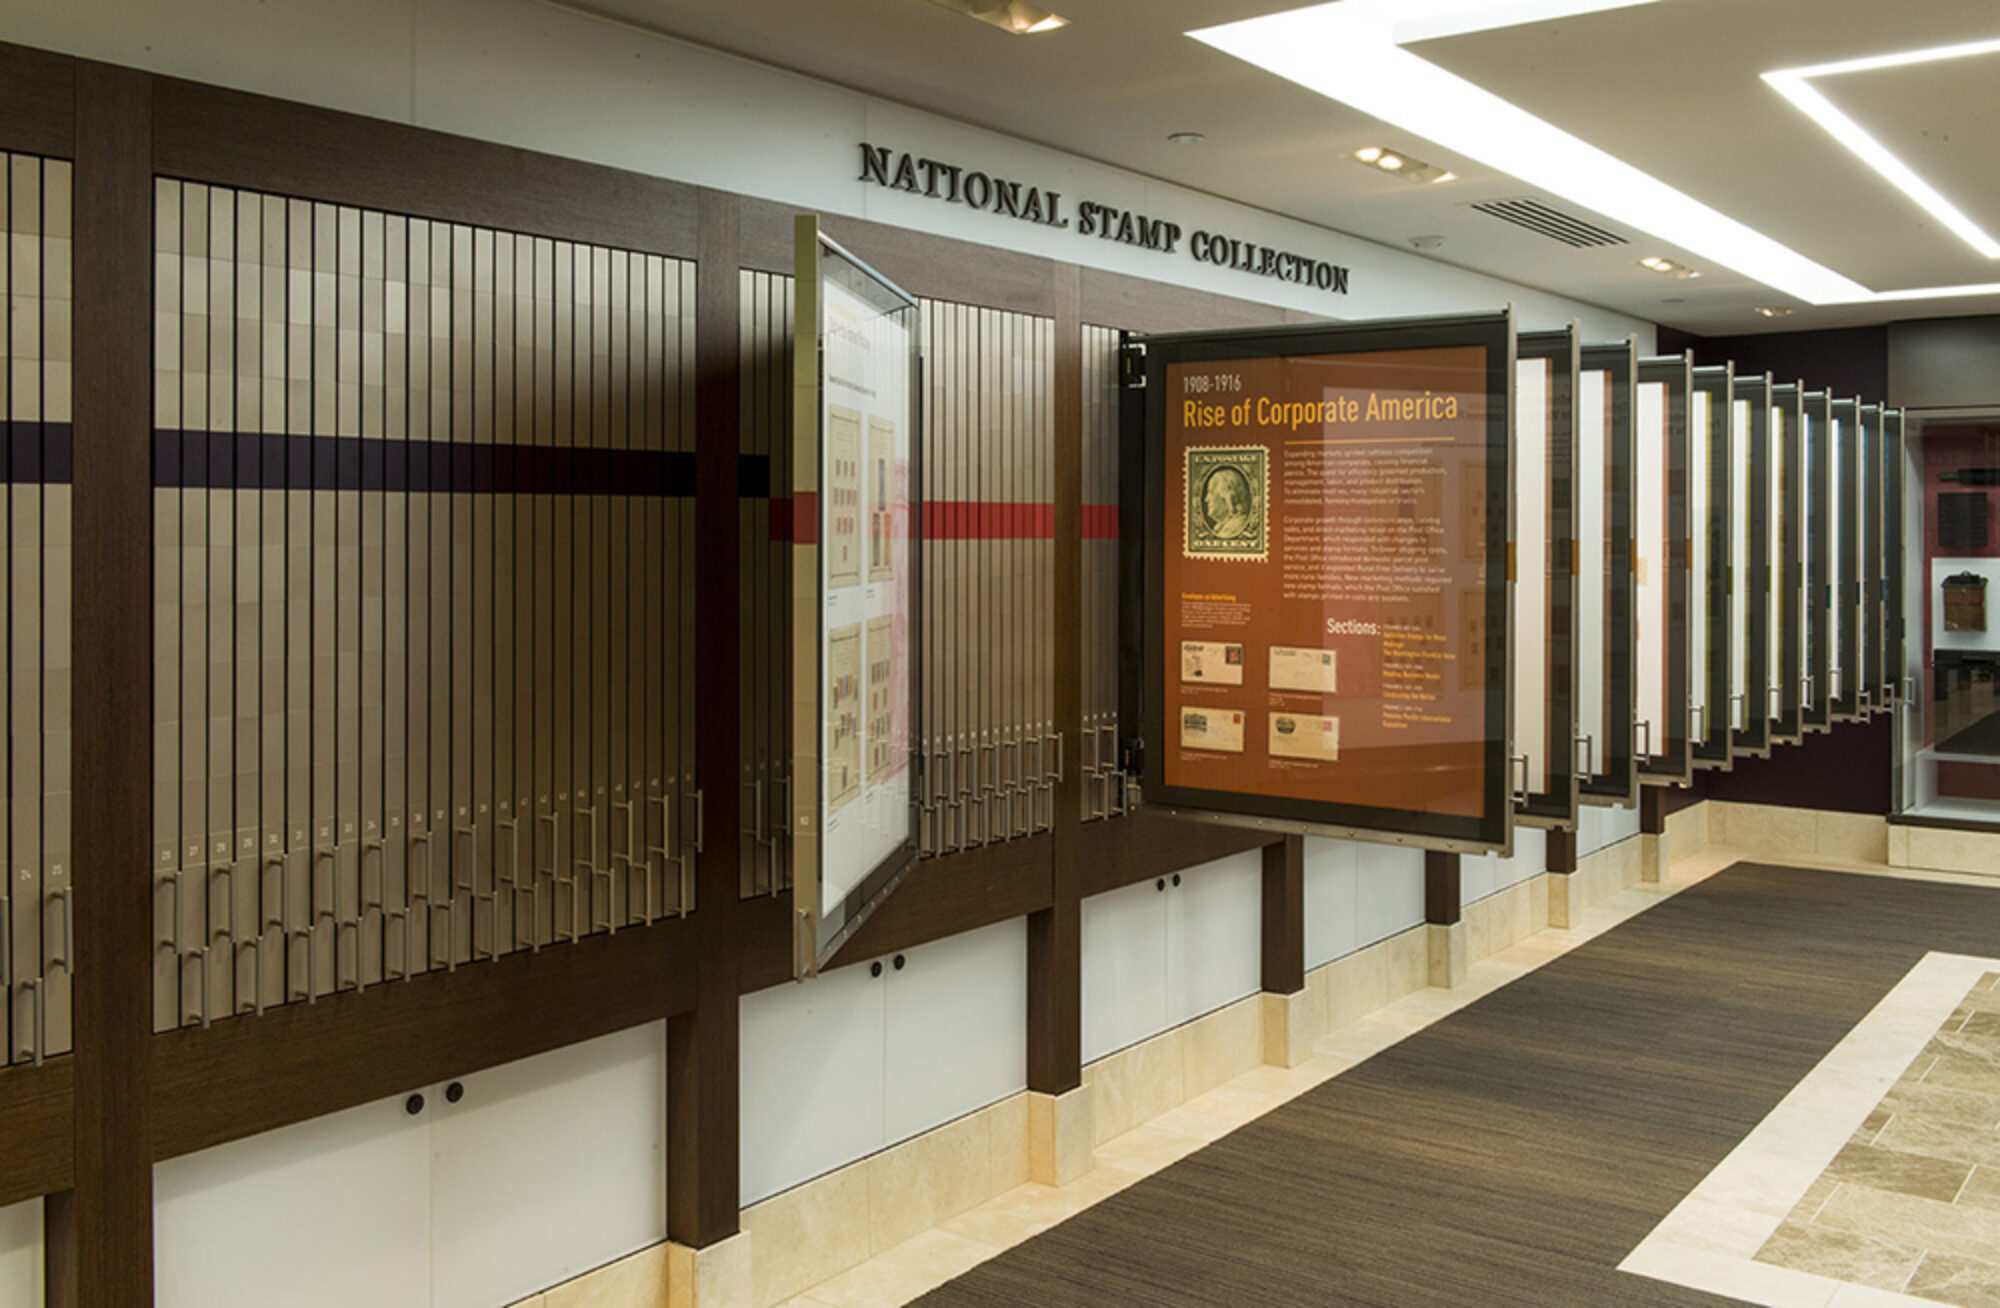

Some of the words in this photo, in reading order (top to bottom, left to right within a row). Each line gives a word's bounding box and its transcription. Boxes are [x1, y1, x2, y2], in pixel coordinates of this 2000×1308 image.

[858, 143, 1068, 228] NATIONAL
[1078, 201, 1181, 253] STAMP
[1191, 230, 1349, 294] COLLECTION
[1183, 374, 1241, 393] 1908-1916
[1183, 400, 1225, 428] Rise
[1231, 398, 1251, 426] of
[1257, 396, 1359, 431] Corporate
[1365, 390, 1458, 422] America
[1327, 617, 1382, 636] Sections:
